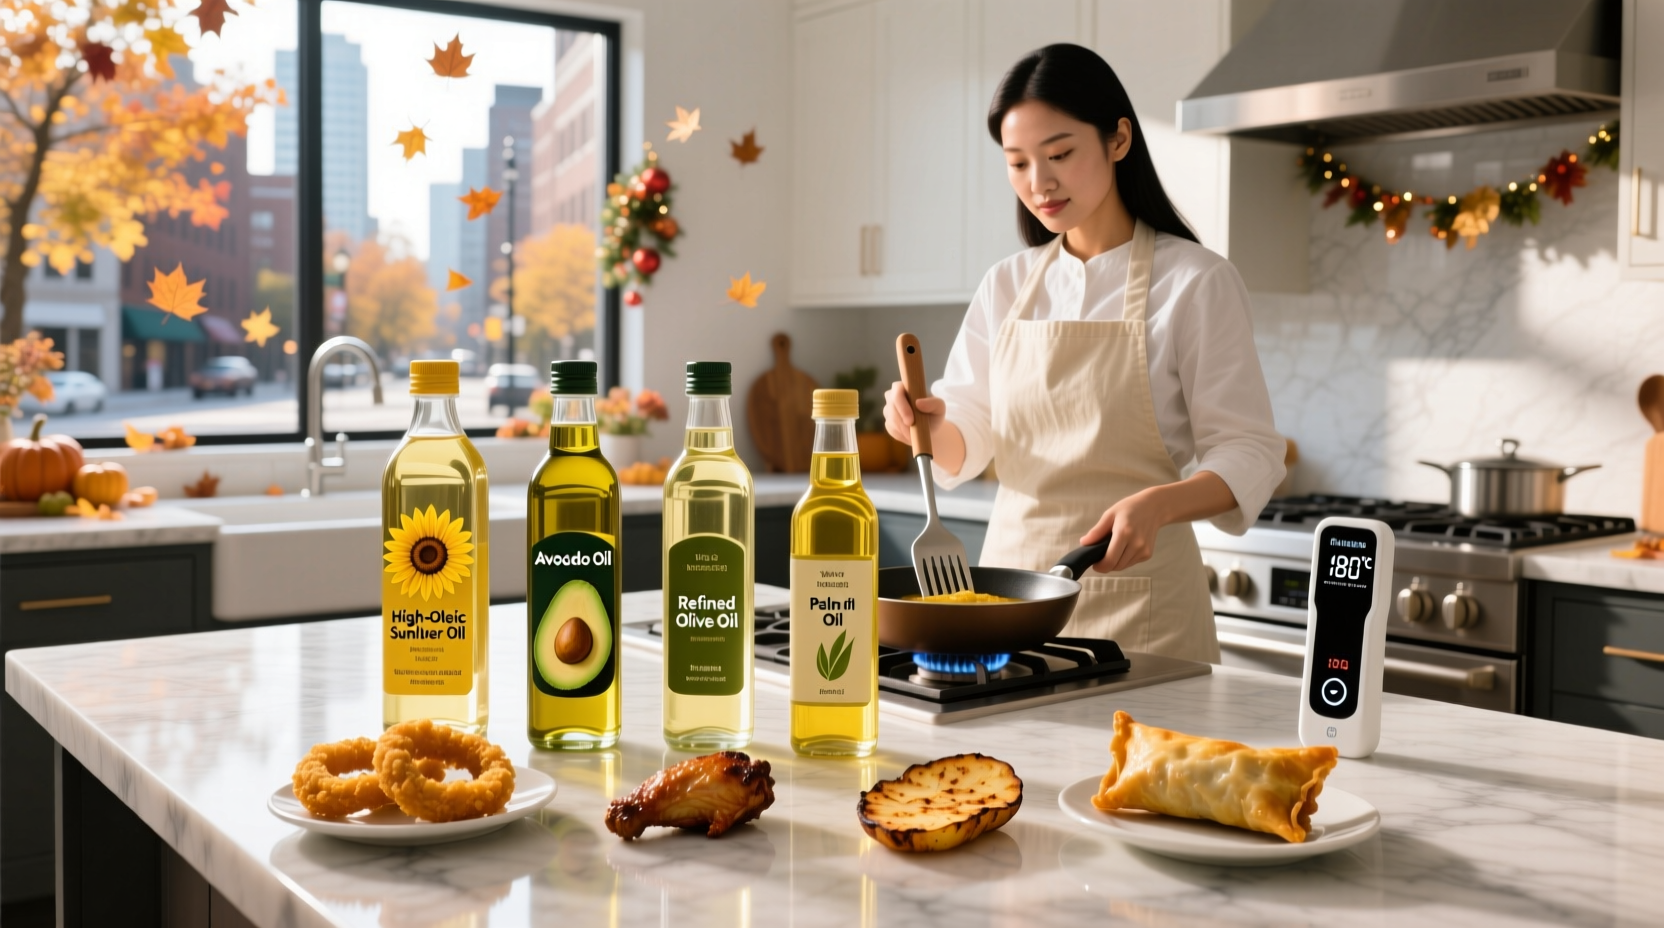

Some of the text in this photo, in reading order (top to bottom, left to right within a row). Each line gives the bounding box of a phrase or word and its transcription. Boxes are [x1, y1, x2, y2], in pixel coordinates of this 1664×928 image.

[678, 595, 736, 610] Refined
[392, 609, 467, 627] High-Oleic
[675, 612, 739, 628] Olive Oil
[822, 612, 843, 626] Oil
